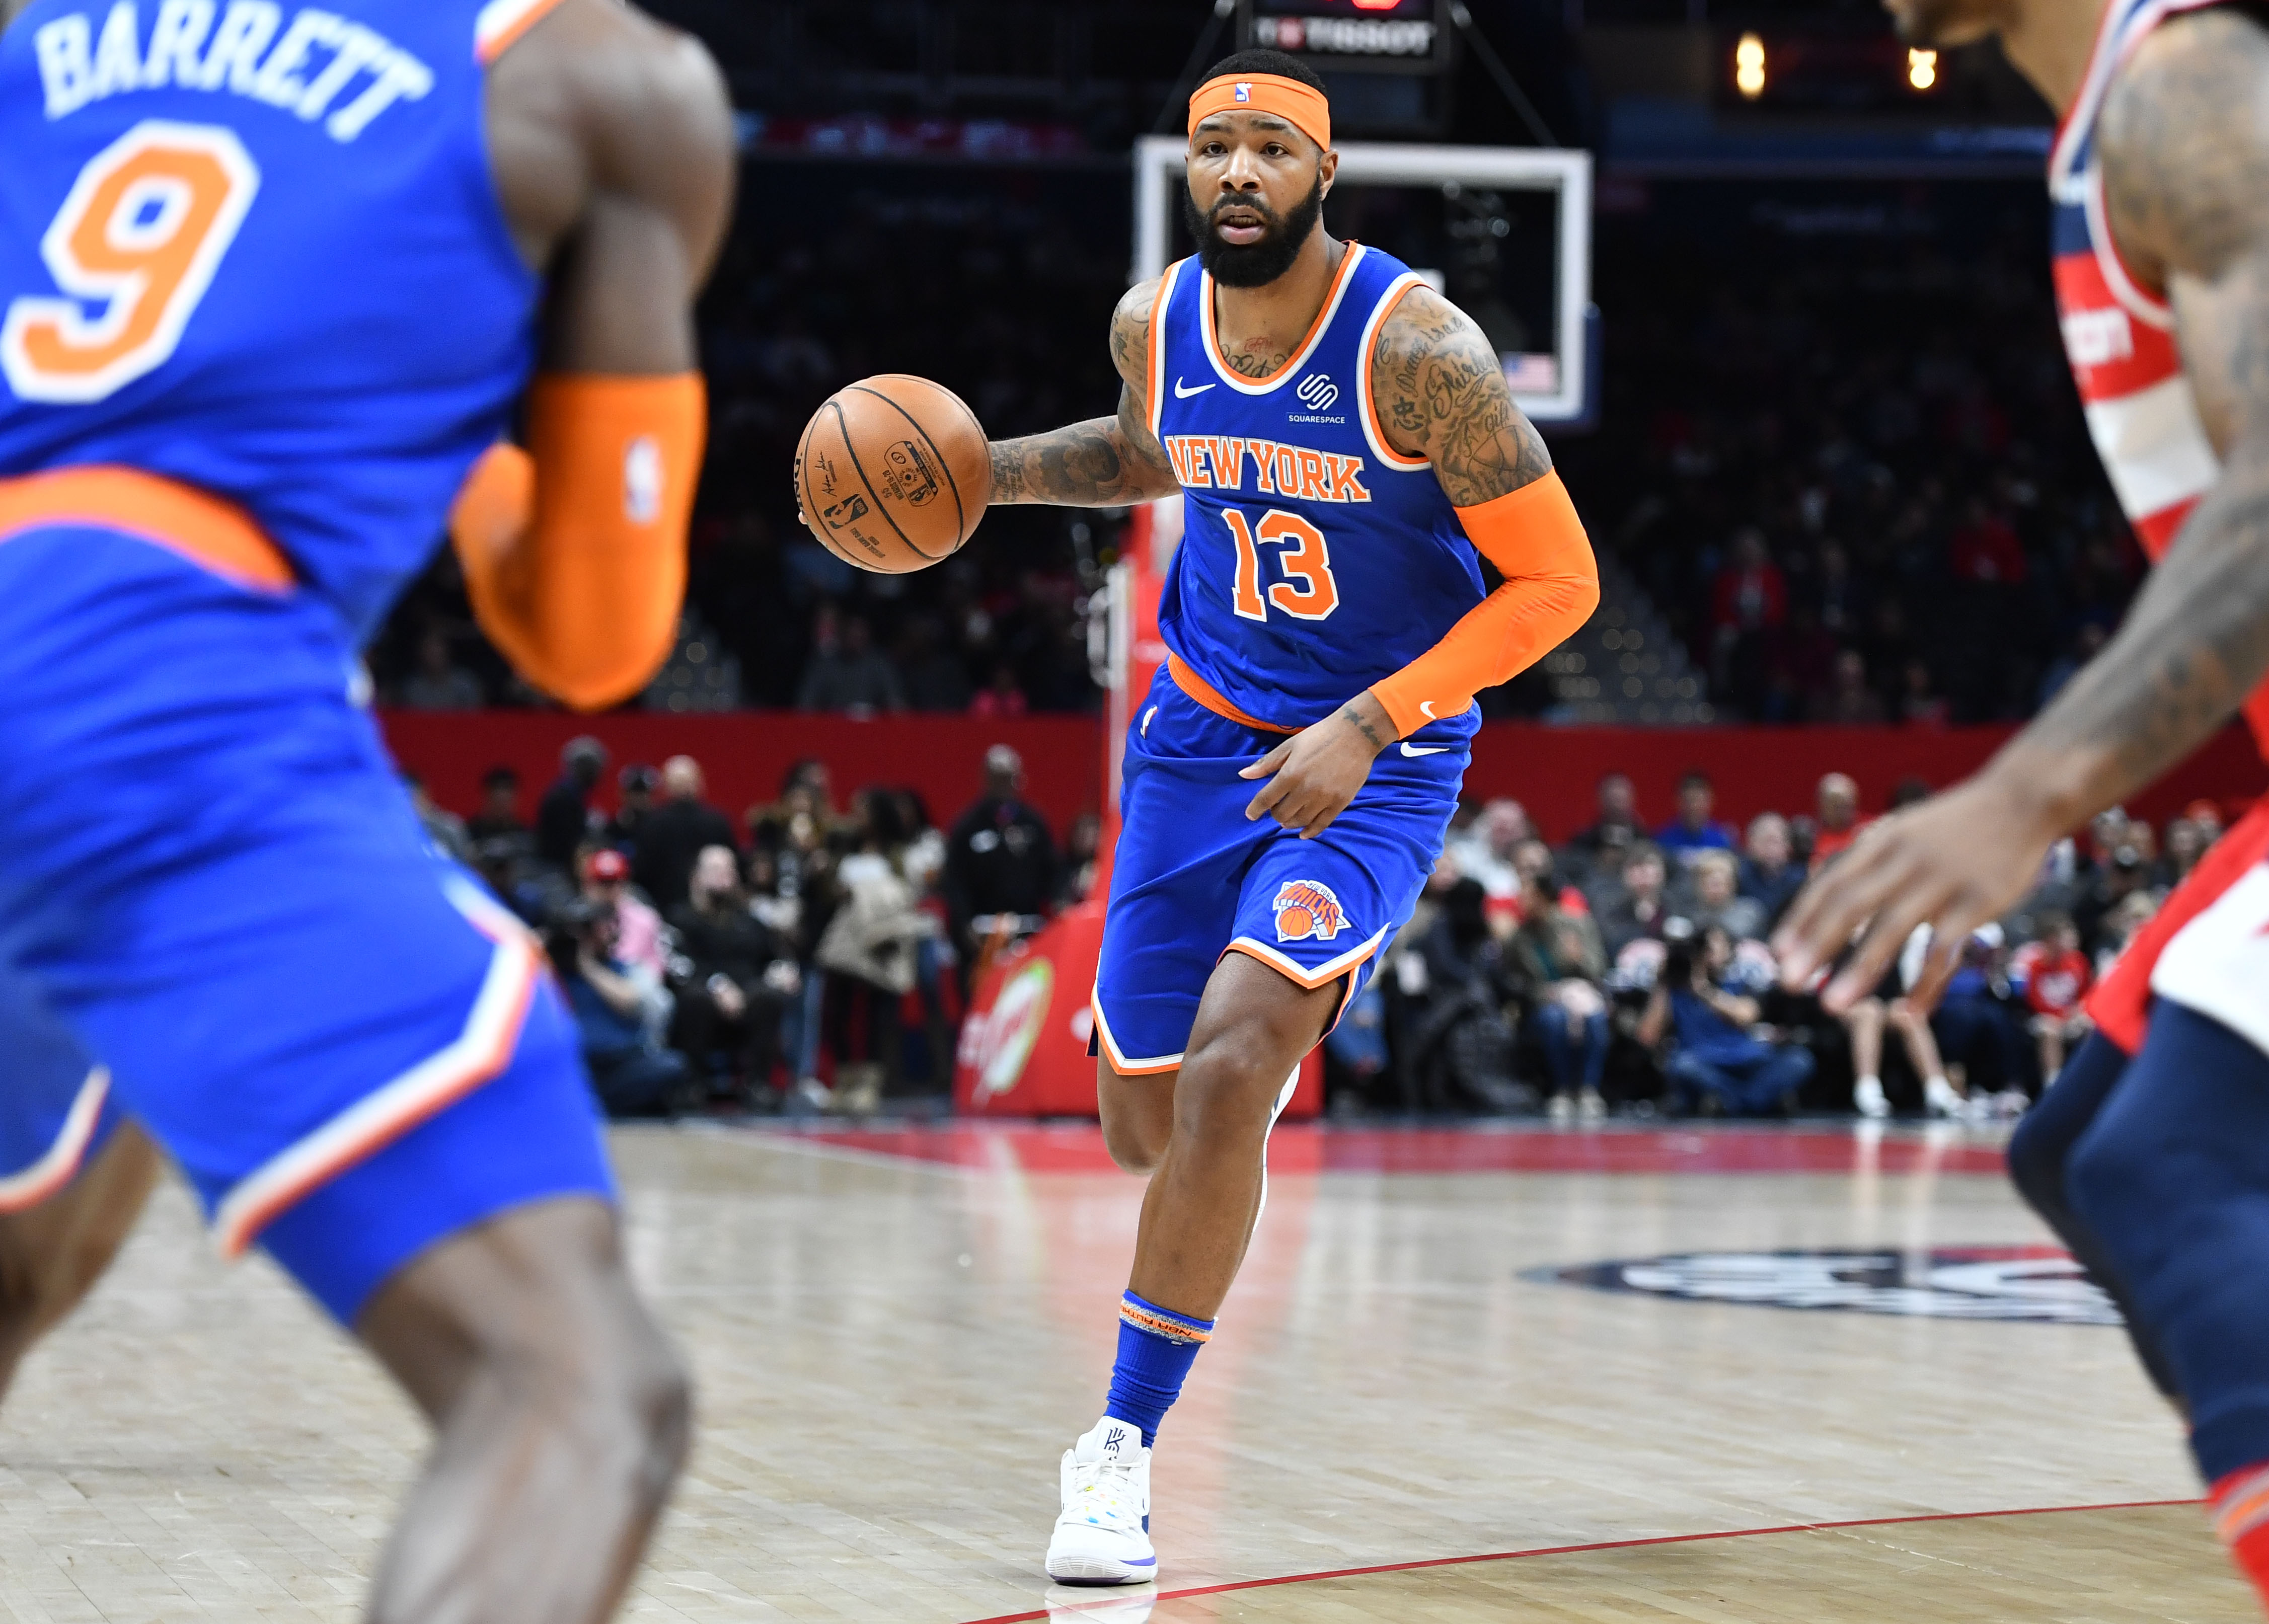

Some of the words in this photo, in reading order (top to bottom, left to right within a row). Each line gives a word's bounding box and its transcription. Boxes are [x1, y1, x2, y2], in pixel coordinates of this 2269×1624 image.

[33, 0, 435, 144] BARRETT
[0, 119, 263, 405] 9
[1288, 414, 1345, 424] SQUARESPACE
[913, 454, 924, 468] BALL
[1163, 435, 1246, 490] NEW
[1246, 437, 1372, 503] YORK
[1221, 508, 1339, 622] 13
[1276, 883, 1339, 936] KNICKS
[1308, 883, 1320, 891] NEW
[1320, 888, 1333, 902] YORK
[1158, 1322, 1192, 1337] NBA
